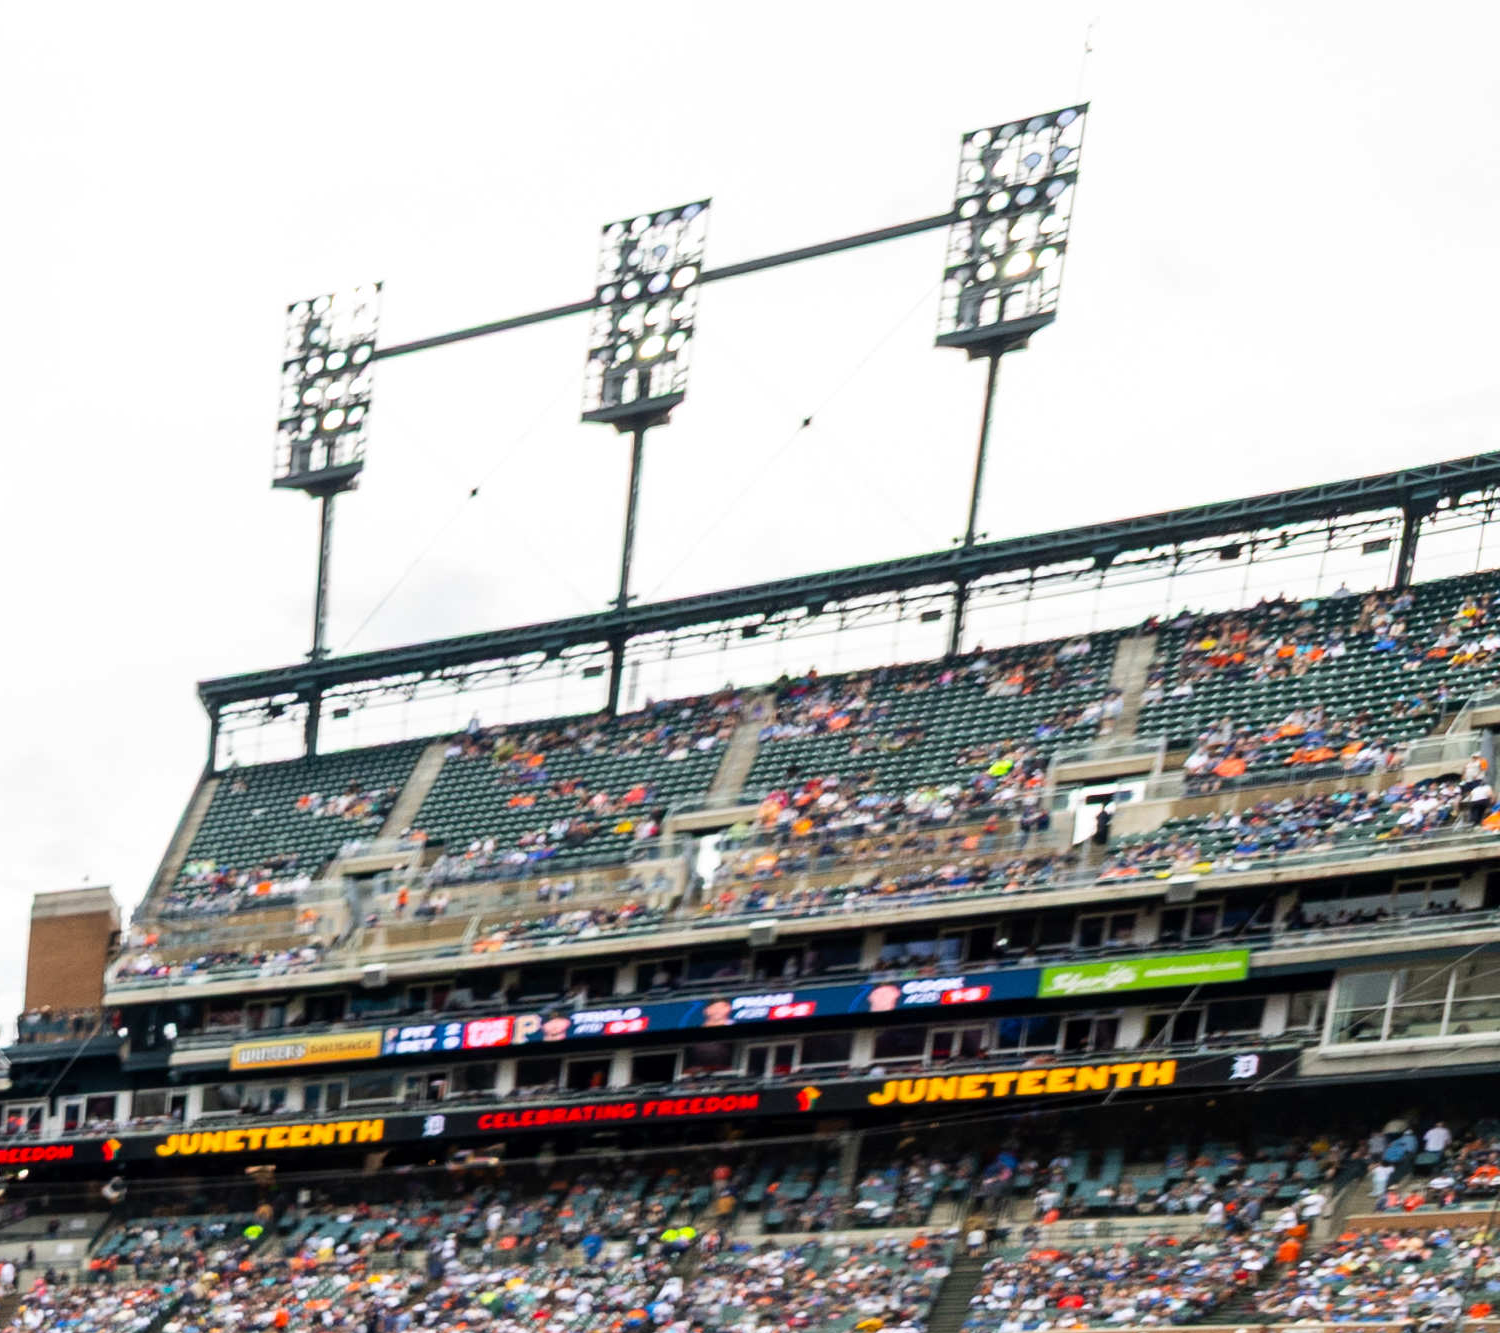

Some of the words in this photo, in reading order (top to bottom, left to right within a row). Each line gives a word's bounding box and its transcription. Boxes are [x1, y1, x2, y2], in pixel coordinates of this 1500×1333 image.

[868, 1059, 1178, 1106] JUNETEENTH
[477, 1103, 636, 1130] CELEBRATING
[642, 1094, 760, 1117] FREEDOM
[155, 1118, 385, 1157] JUNETEENTH
